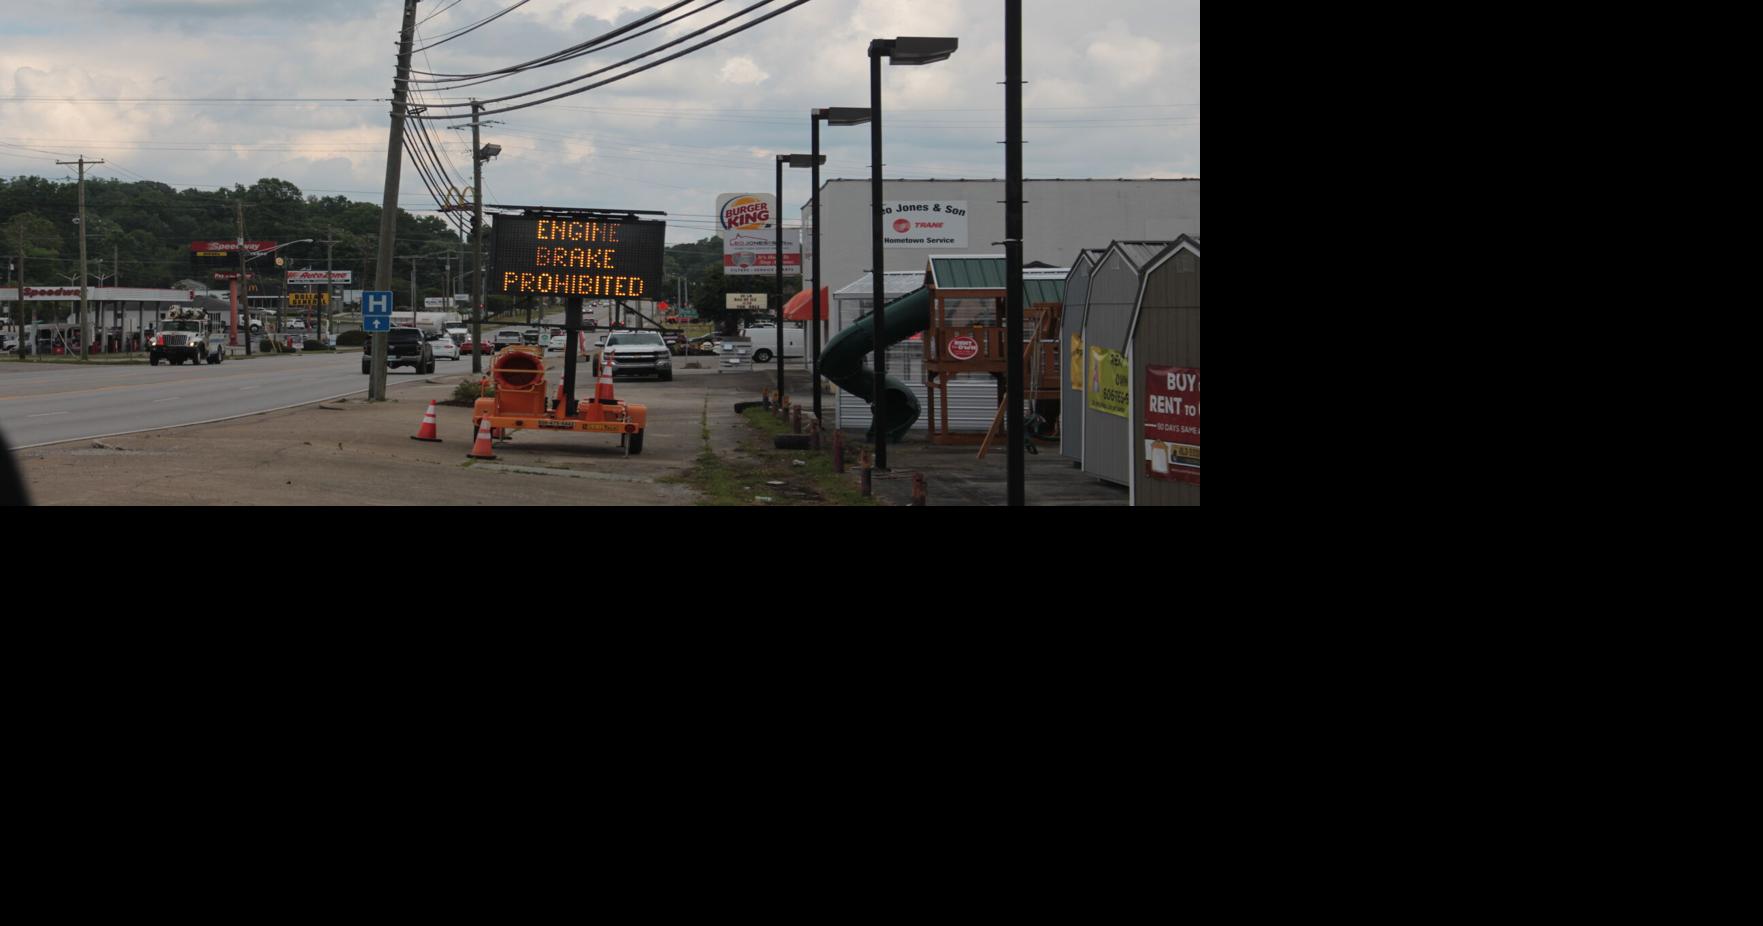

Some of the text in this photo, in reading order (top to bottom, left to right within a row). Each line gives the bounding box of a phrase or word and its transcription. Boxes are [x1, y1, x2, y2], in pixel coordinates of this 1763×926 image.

[725, 202, 768, 218] BURGER
[896, 203, 929, 213] Jones
[933, 203, 942, 212] &
[945, 205, 966, 217] Son
[726, 211, 769, 230] KING
[537, 219, 622, 243] ENGINE
[536, 246, 616, 269] BRAKE
[23, 287, 81, 298] Speedwa
[503, 271, 645, 297] PROHIBITED
[369, 294, 388, 312] H
[1167, 372, 1196, 392] BUY
[1150, 394, 1182, 415] RENT
[1184, 405, 1196, 417] TO
[1165, 423, 1181, 433] DAYS
[1181, 424, 1198, 435] SAME
